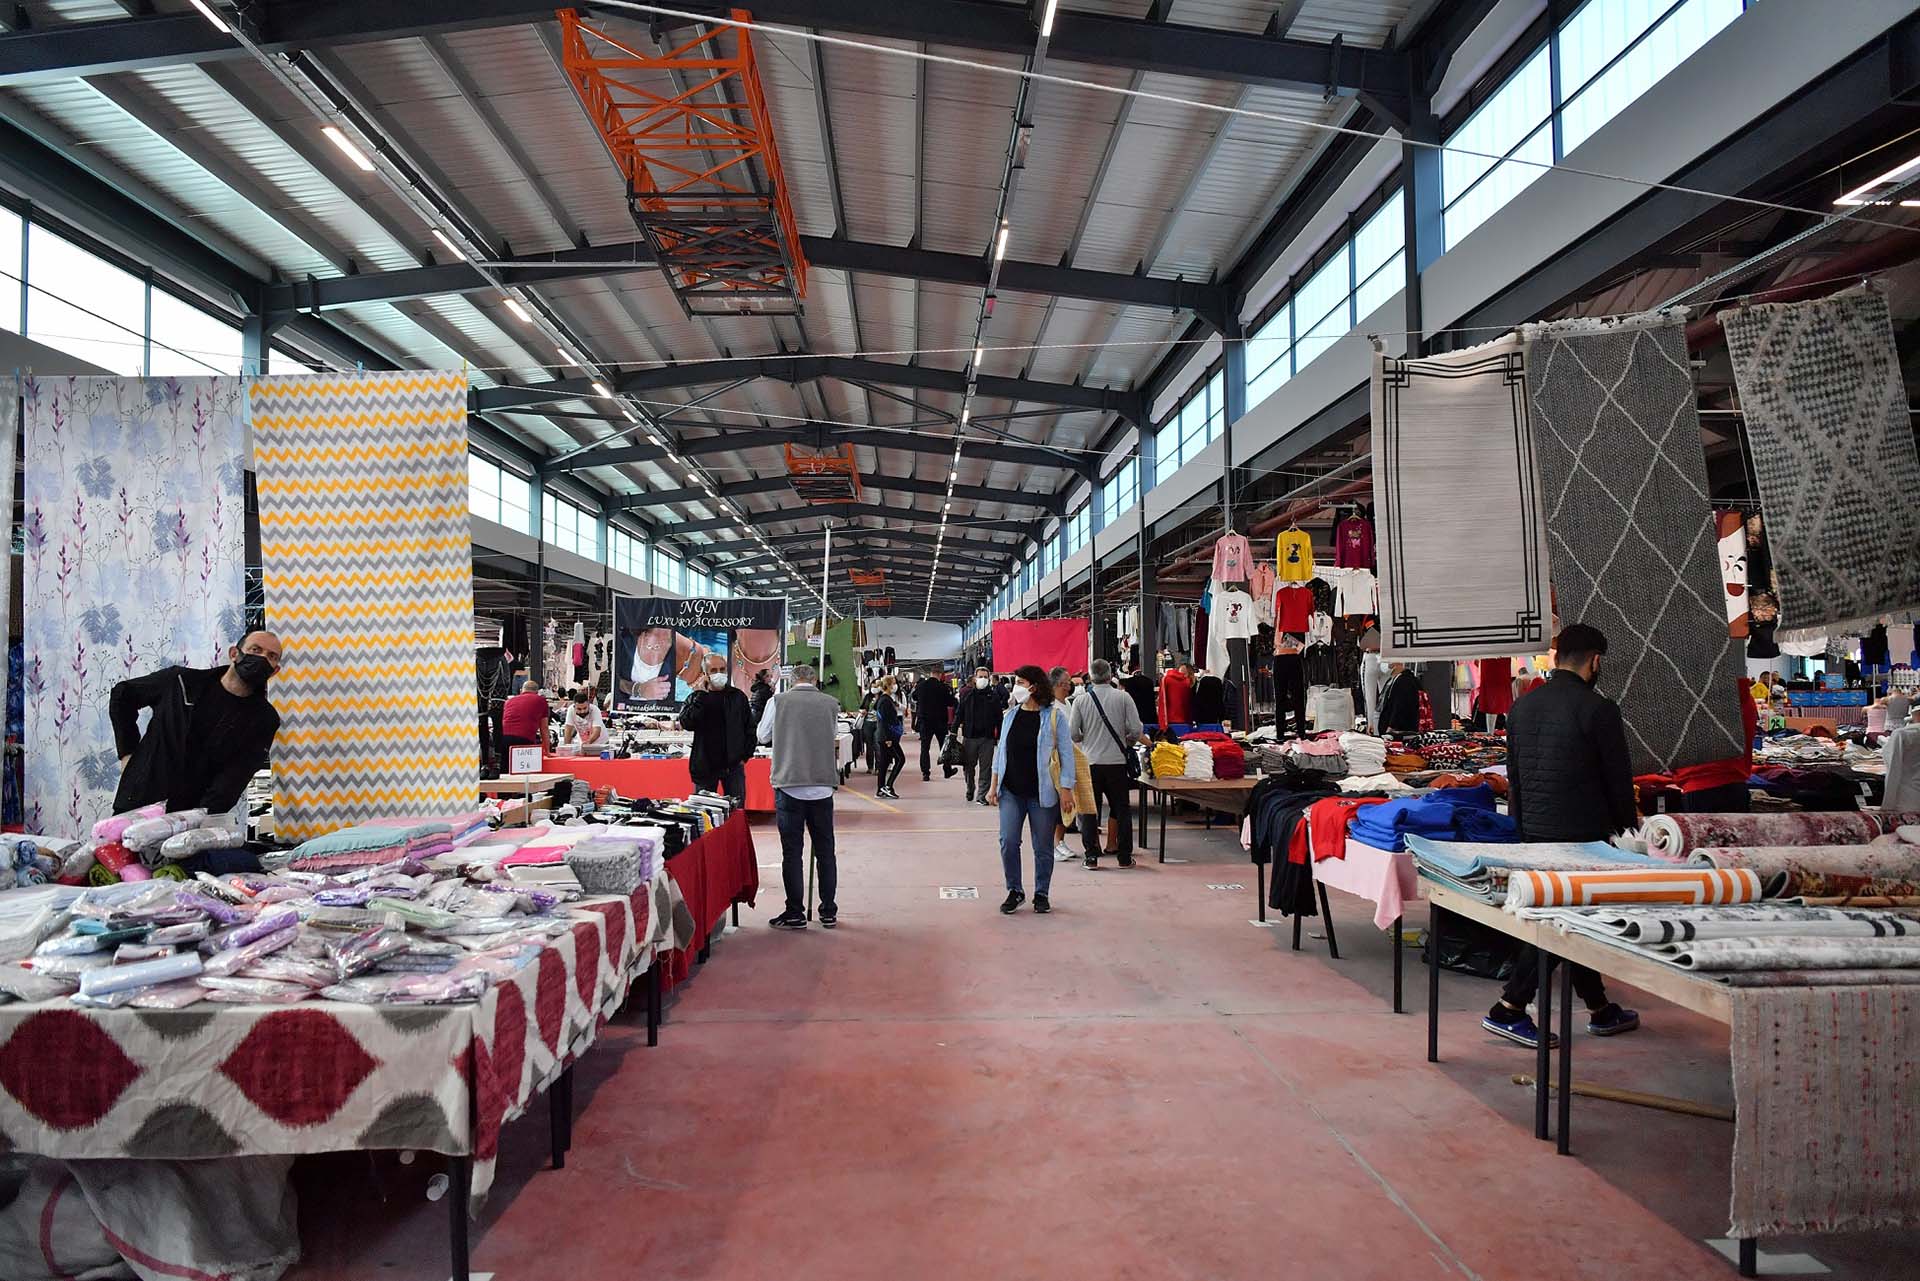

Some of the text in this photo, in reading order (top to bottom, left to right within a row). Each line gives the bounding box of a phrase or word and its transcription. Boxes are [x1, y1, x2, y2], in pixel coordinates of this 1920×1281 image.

[680, 599, 722, 617] NGN
[647, 615, 755, 628] LUXURY ACCESSORY
